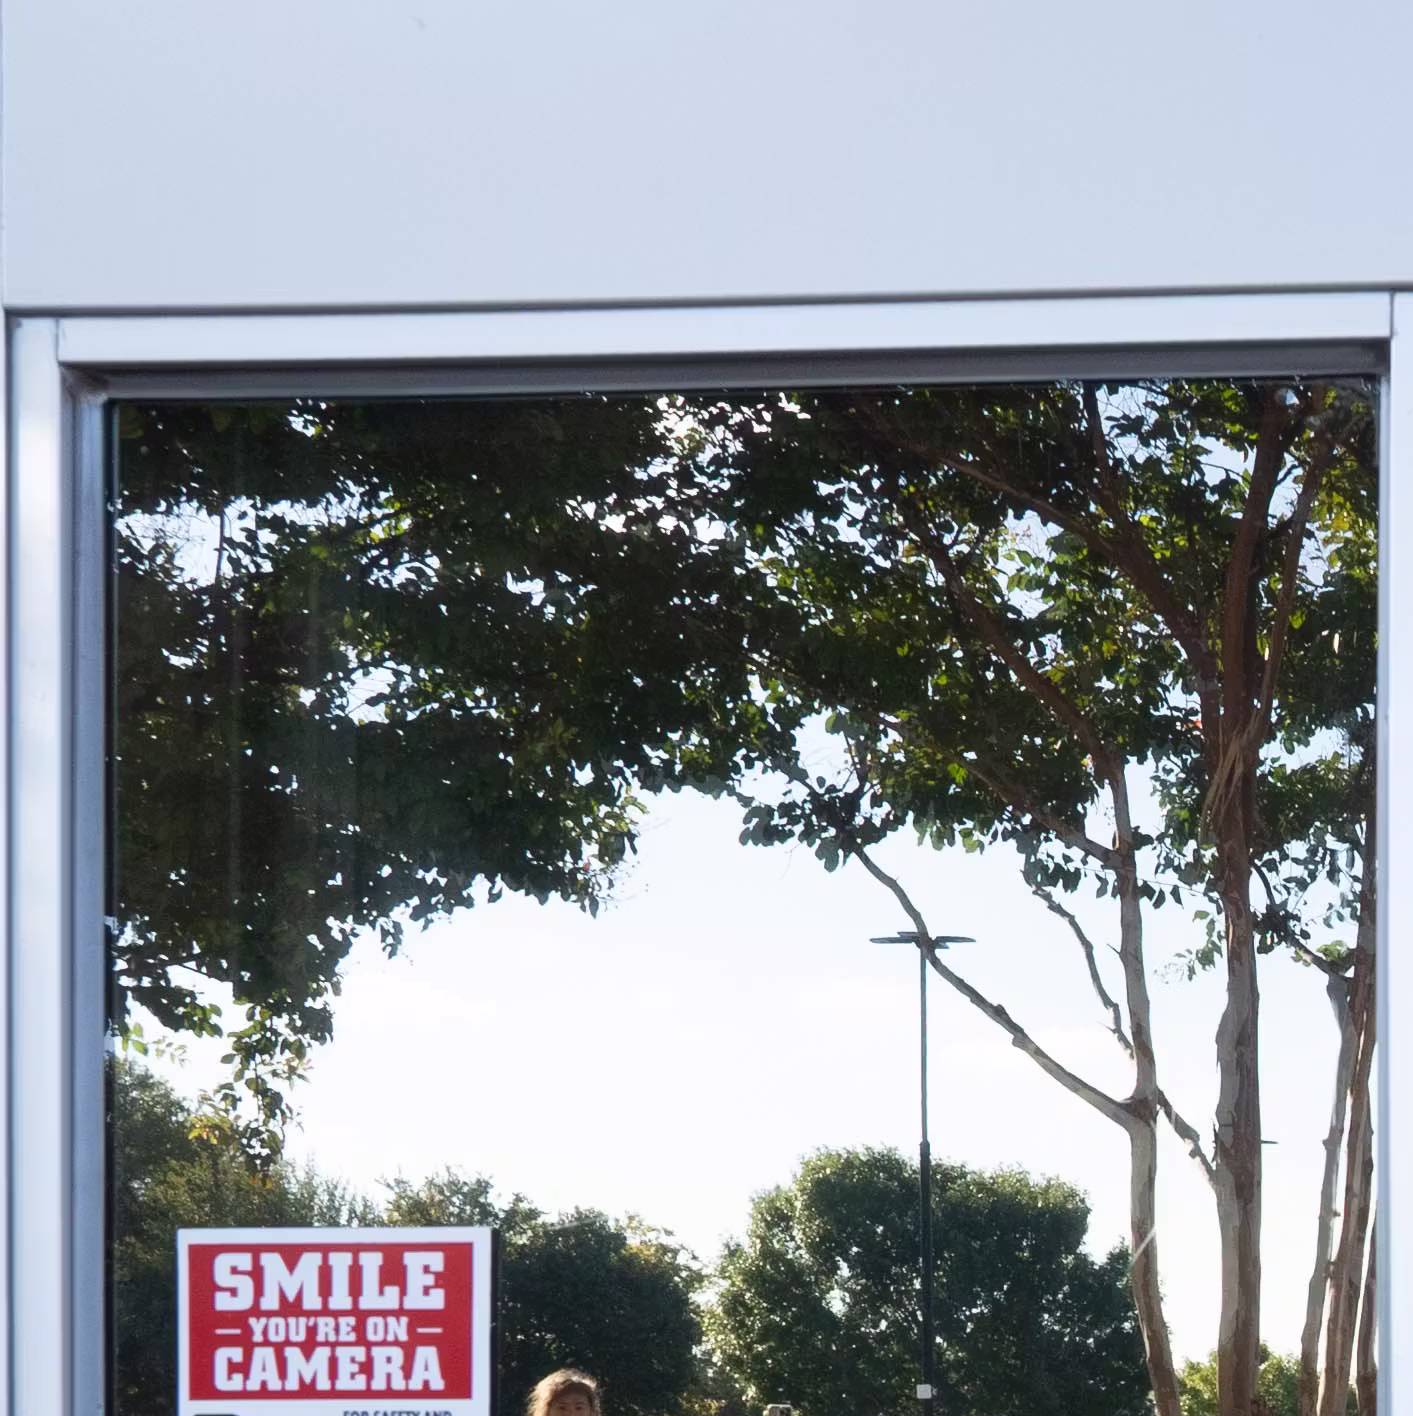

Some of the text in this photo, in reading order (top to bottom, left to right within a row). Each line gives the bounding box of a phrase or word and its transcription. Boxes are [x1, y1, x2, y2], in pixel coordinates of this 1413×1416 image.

[214, 1251, 445, 1311] SMILE
[249, 1316, 408, 1342] YOU'RE ON
[214, 1346, 445, 1391] CAMERA
